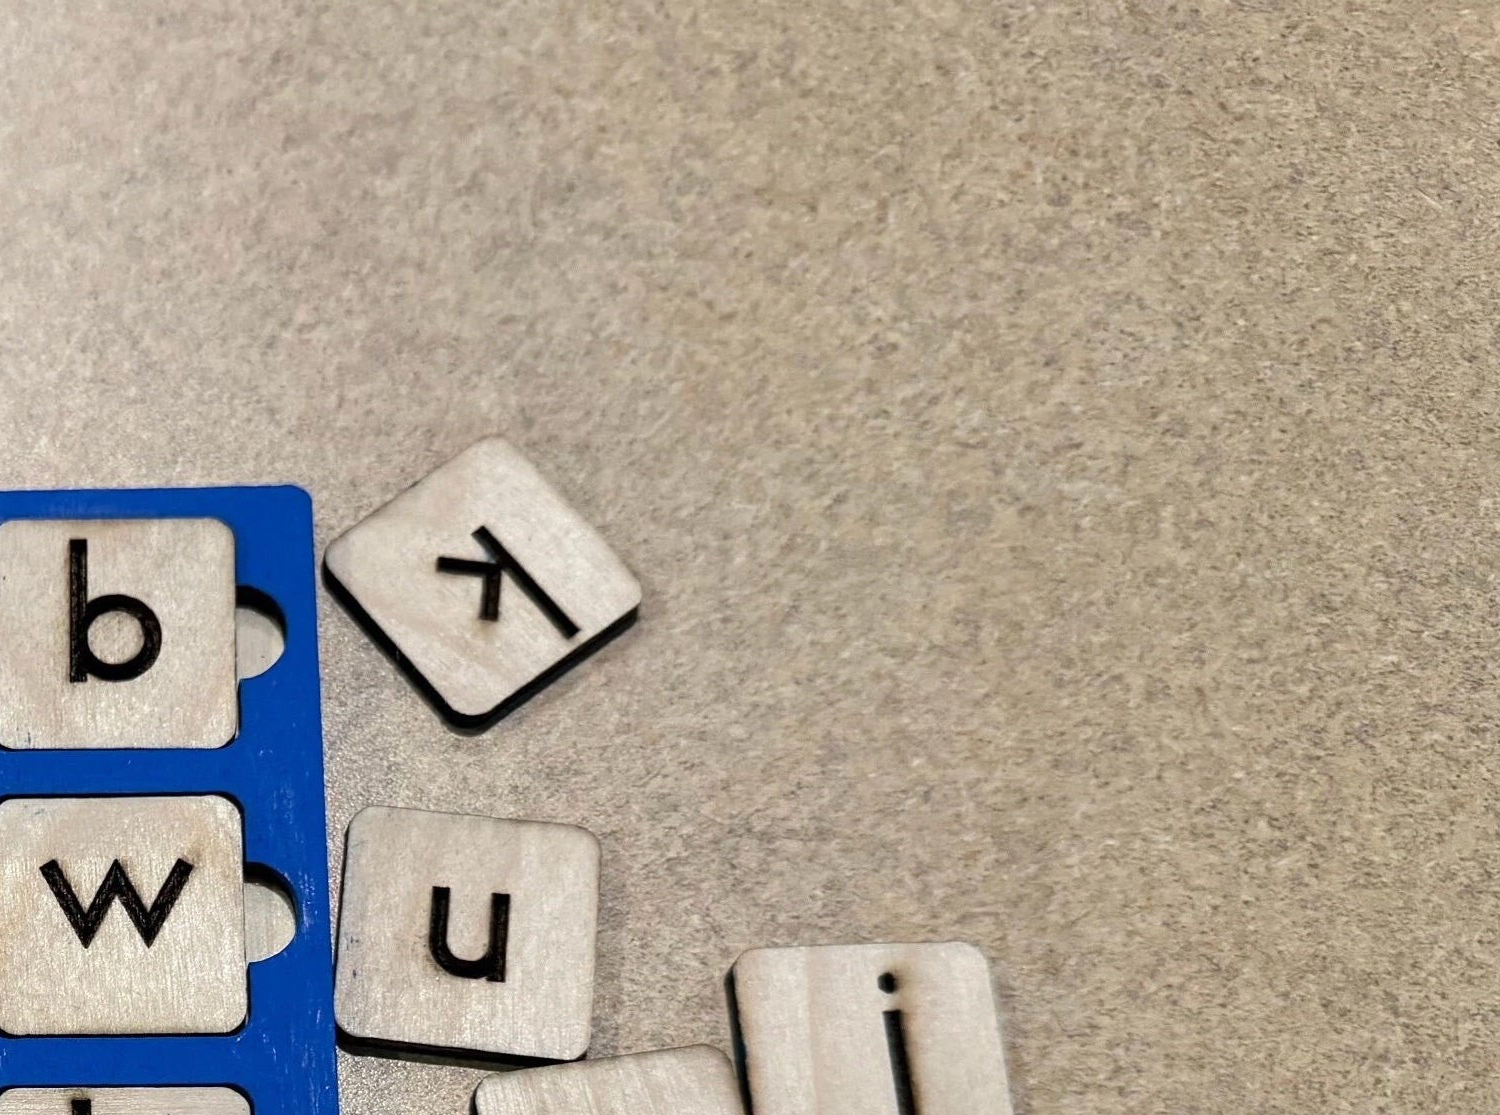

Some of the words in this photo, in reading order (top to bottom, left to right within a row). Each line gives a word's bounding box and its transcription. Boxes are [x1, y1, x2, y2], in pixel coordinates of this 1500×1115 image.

[69, 539, 162, 683] b
[437, 526, 580, 639] k
[39, 858, 194, 948] w
